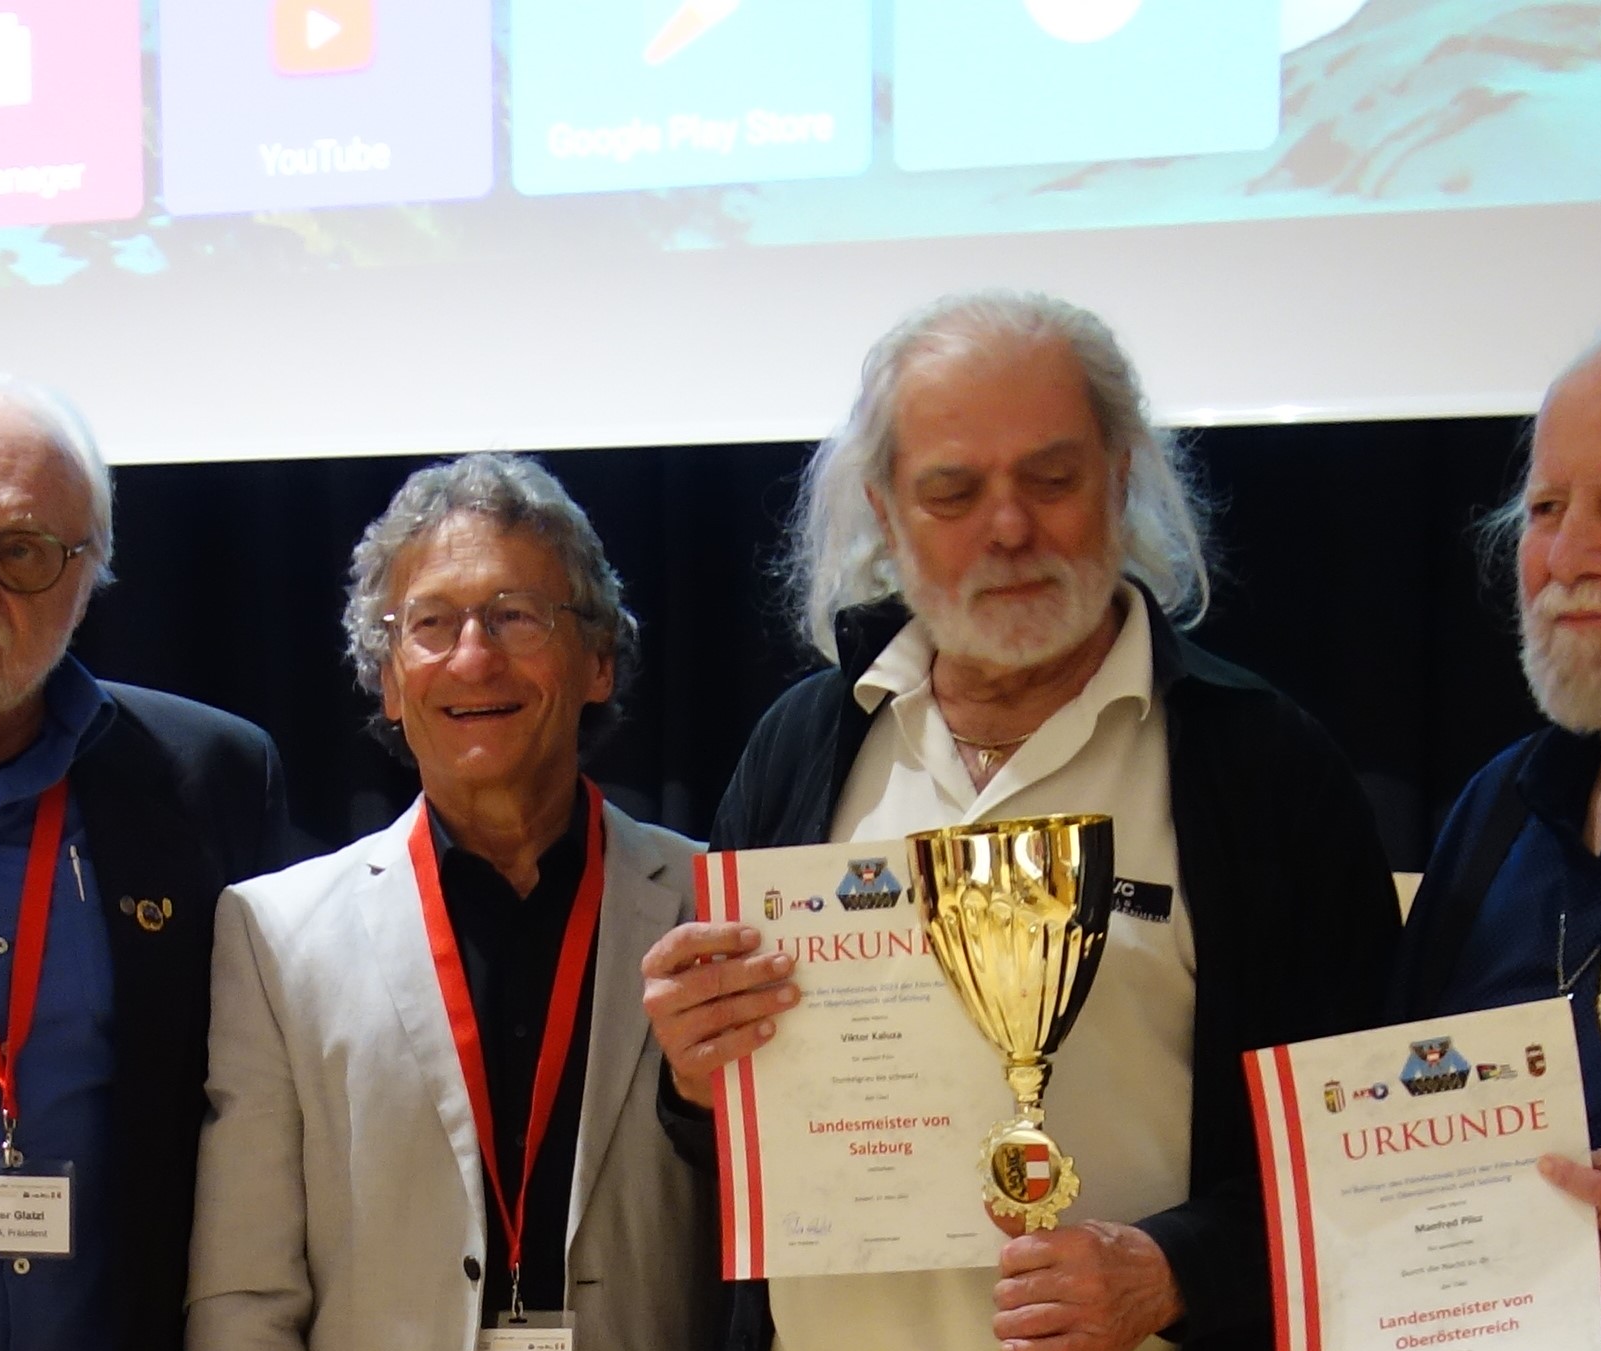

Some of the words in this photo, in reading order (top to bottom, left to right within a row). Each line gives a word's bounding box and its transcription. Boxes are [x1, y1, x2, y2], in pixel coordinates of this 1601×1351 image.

[546, 116, 662, 165] Google
[666, 112, 739, 157] Play
[744, 108, 838, 146] Store
[258, 137, 392, 178] YouTube
[840, 1031, 869, 1042] Viktor
[809, 1115, 919, 1134] Landesmeister
[921, 1114, 951, 1127] von
[1342, 1099, 1549, 1161] URKUNDE
[849, 1140, 913, 1156] Salzburg
[7, 1228, 48, 1238] Präsident
[1414, 1219, 1459, 1234] Manfred
[1379, 1298, 1498, 1330] Landesmeister
[1502, 1293, 1534, 1308] von
[1395, 1318, 1520, 1350] Oberösterreich
